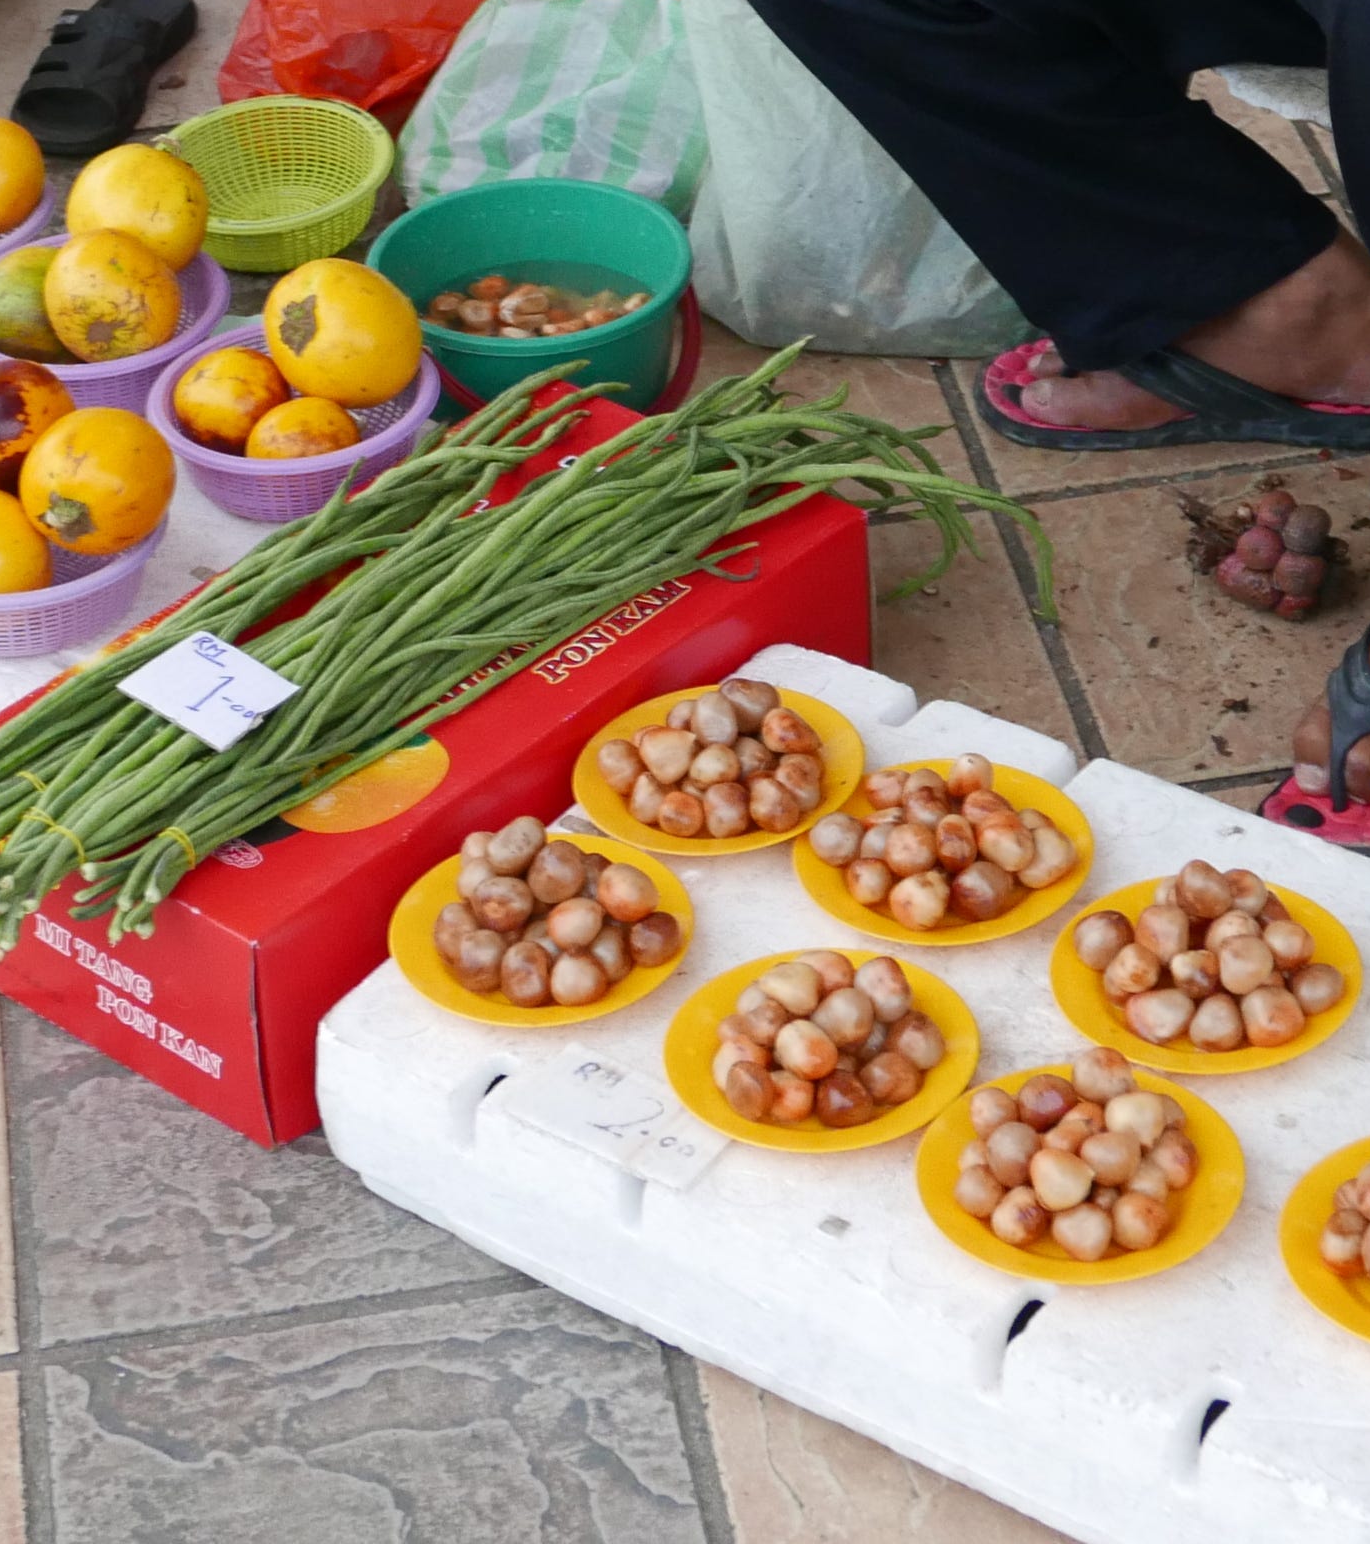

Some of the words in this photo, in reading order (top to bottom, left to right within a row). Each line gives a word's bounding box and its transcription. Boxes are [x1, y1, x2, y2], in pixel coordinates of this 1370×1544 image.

[532, 626, 617, 685] PON
[34, 913, 72, 957] MI
[73, 937, 154, 1005] TANG
[95, 983, 157, 1039] PON
[159, 1022, 224, 1081] KAN
